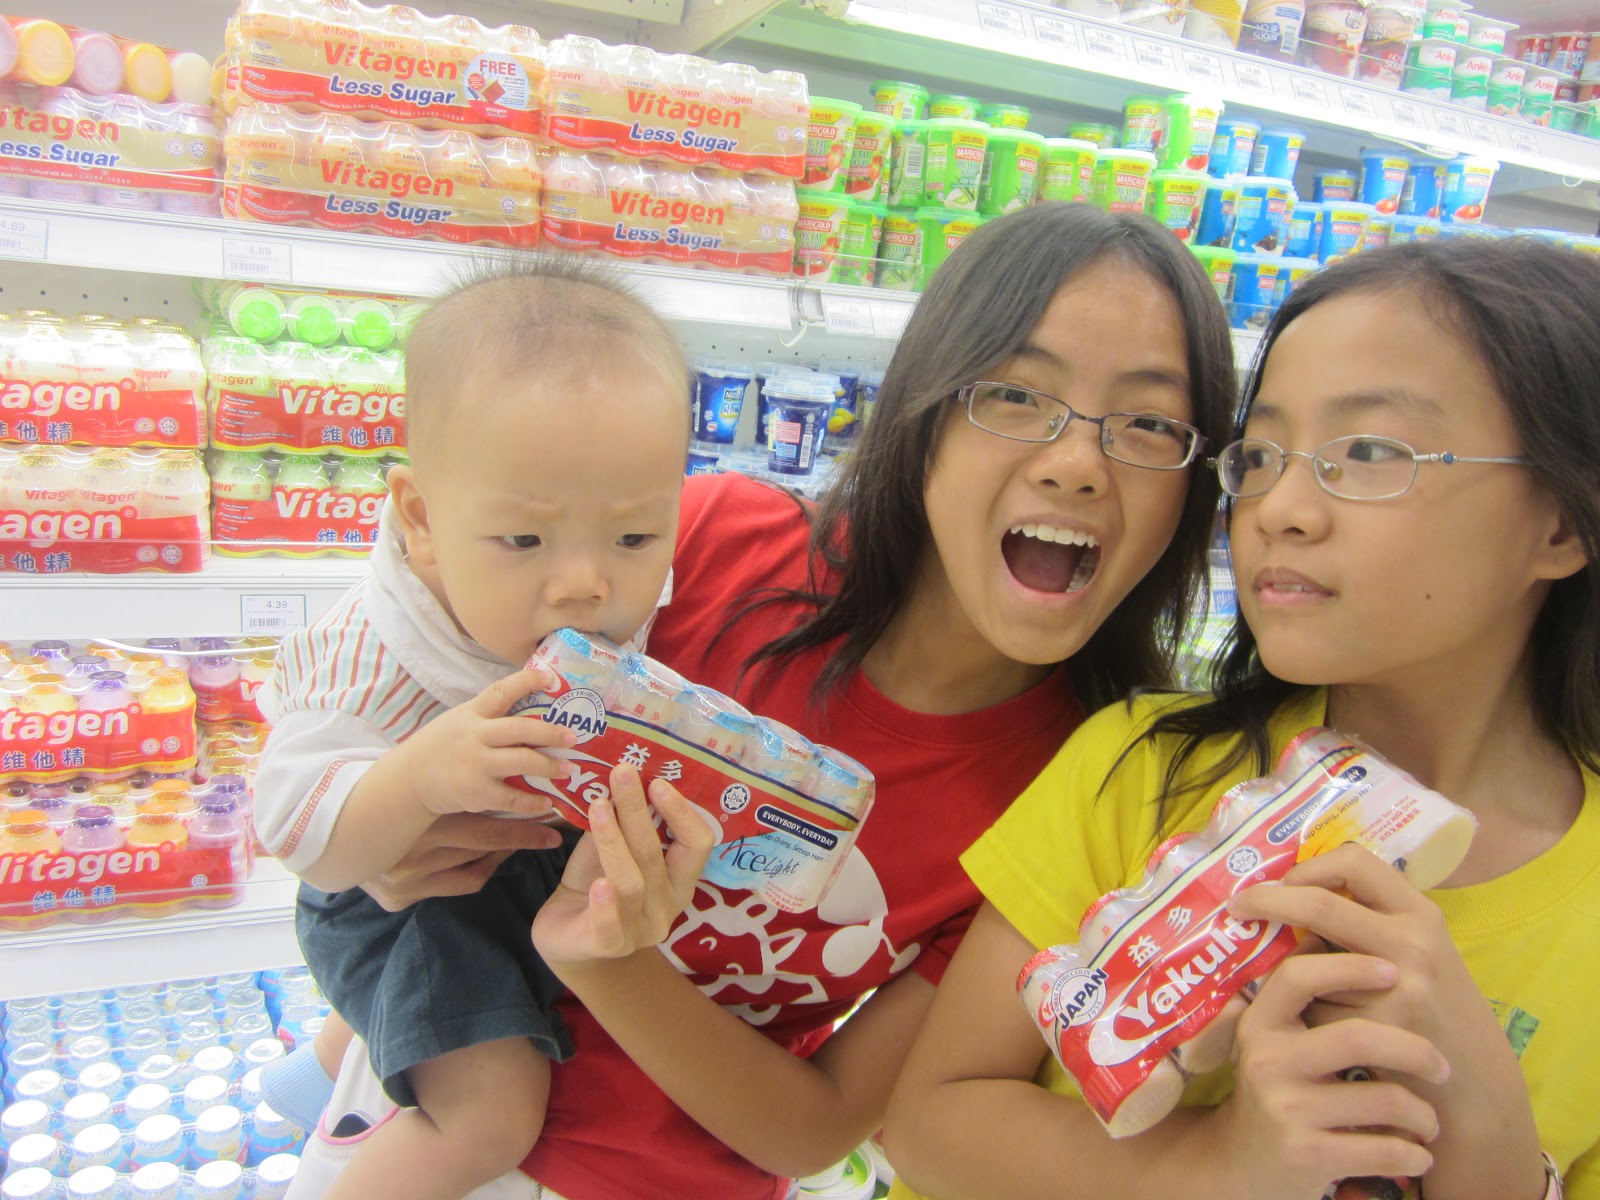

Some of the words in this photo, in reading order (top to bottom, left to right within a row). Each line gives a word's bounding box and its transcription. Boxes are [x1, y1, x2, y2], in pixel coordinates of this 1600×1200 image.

[323, 40, 458, 80] Vitagen
[480, 59, 516, 76] FREE
[330, 75, 383, 96] Less
[389, 82, 456, 105] Sugar
[627, 89, 742, 128] Vitagen
[0, 106, 119, 142] itagen
[630, 122, 676, 142] Less
[681, 130, 738, 152] Sugar
[808, 124, 836, 136] ARIGOLD
[0, 142, 42, 160] ess
[49, 143, 120, 168] Sugar
[320, 158, 455, 198] Vitagen
[325, 193, 379, 214] Less
[385, 201, 453, 224] Sugar
[610, 190, 725, 226] Vitagen
[614, 222, 660, 242] Less
[666, 227, 724, 250] Sugar
[0, 381, 121, 417] agen
[280, 388, 406, 422] Vitage
[322, 425, 395, 446] 维他精
[25, 489, 76, 501] Vitage
[275, 491, 385, 525] Vitag
[0, 513, 121, 548] agen
[316, 528, 379, 548] 维他
[266, 600, 288, 609] 4.39
[557, 691, 575, 707] FIRST
[576, 690, 603, 710] PRODUCED
[0, 710, 129, 744] tagen
[542, 707, 608, 736] JAPAN
[3, 748, 85, 770] 维他精
[762, 810, 801, 833] EVERYBODY,
[802, 827, 834, 847] EVERYDAY
[1315, 813, 1339, 832] Orang,
[1337, 795, 1359, 815] Setiap
[1359, 817, 1383, 837] Minuman
[1365, 820, 1391, 841] Cultured
[792, 844, 811, 858] Setiap
[811, 851, 825, 862] Hari
[1128, 905, 1193, 968] 益多
[1055, 969, 1083, 992] PRODUCED
[1119, 915, 1262, 1028] Yakult
[1060, 967, 1109, 1030] JAPAN
[1087, 1001, 1103, 1020] 1935
